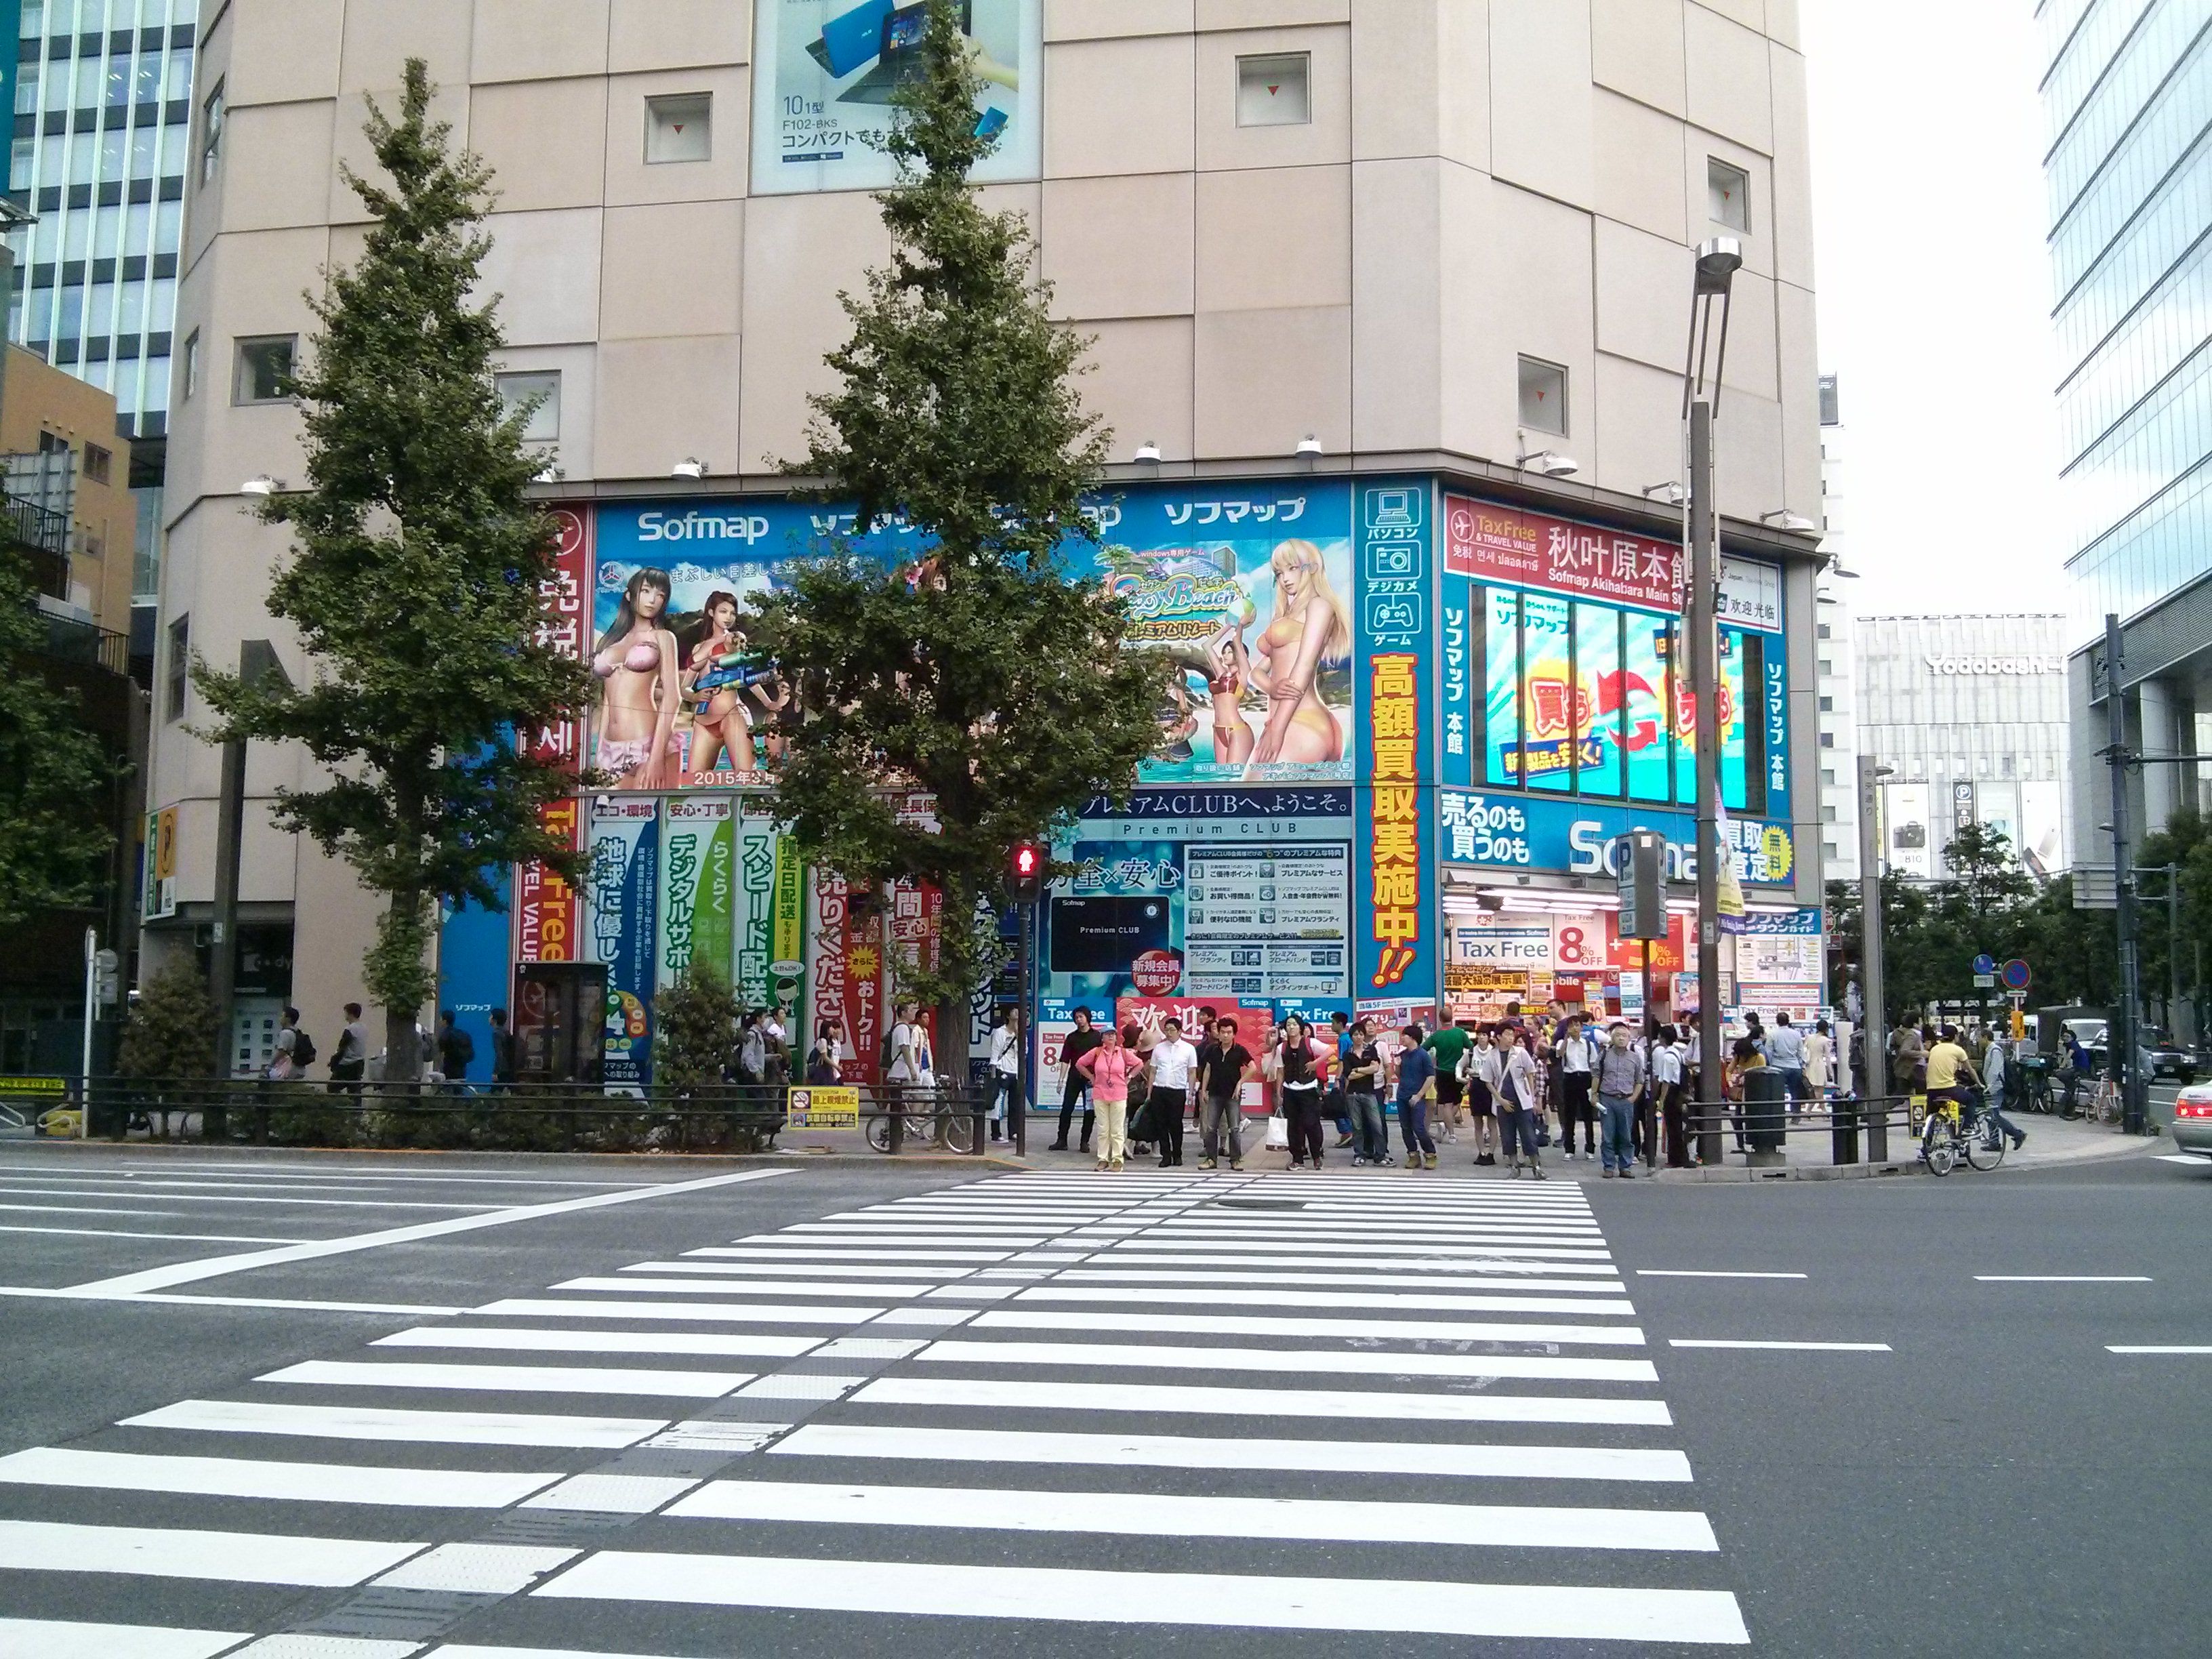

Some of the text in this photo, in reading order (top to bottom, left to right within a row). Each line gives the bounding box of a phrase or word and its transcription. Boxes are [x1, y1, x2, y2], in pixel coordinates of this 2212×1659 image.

[783, 119, 838, 131] F102-BKS
[1164, 497, 1307, 526] ソフマップ
[638, 511, 769, 546] Sofmap
[1367, 529, 1418, 539] パソコン
[1483, 534, 1511, 548] TRAVEL
[1513, 540, 1537, 552] VALUE
[1453, 544, 1472, 559] 免税
[1367, 581, 1418, 592] デジカメ
[1549, 567, 1589, 589] Sofmap
[1591, 577, 1643, 598] Akihabara
[1645, 587, 1669, 602] Main
[1374, 635, 1412, 647] ゲーム
[1446, 608, 1464, 755] ソフマップ 本館
[1767, 663, 1784, 792] ソフマップ 本館
[670, 803, 729, 817] 安心・丁寧
[1441, 793, 1525, 833] 売るのも
[1123, 823, 1297, 835] Premium CLUB
[1452, 825, 1530, 864] 買うのも
[712, 841, 729, 914] らくらく
[1281, 869, 1344, 878] プレミアムなサービス
[739, 835, 773, 1010] スピード配送
[893, 921, 926, 938] 安心
[1080, 926, 1140, 934] Premium CLUB
[1458, 941, 1549, 958] Tax Free
[852, 958, 874, 966] さらに
[1132, 960, 1180, 972] 新規会員
[1581, 957, 1603, 966] OFF
[1657, 956, 1679, 966] OFF
[1136, 974, 1176, 987] 募集中!
[455, 1003, 491, 1011] ソフマップ
[1242, 999, 1269, 1007] Sofmap
